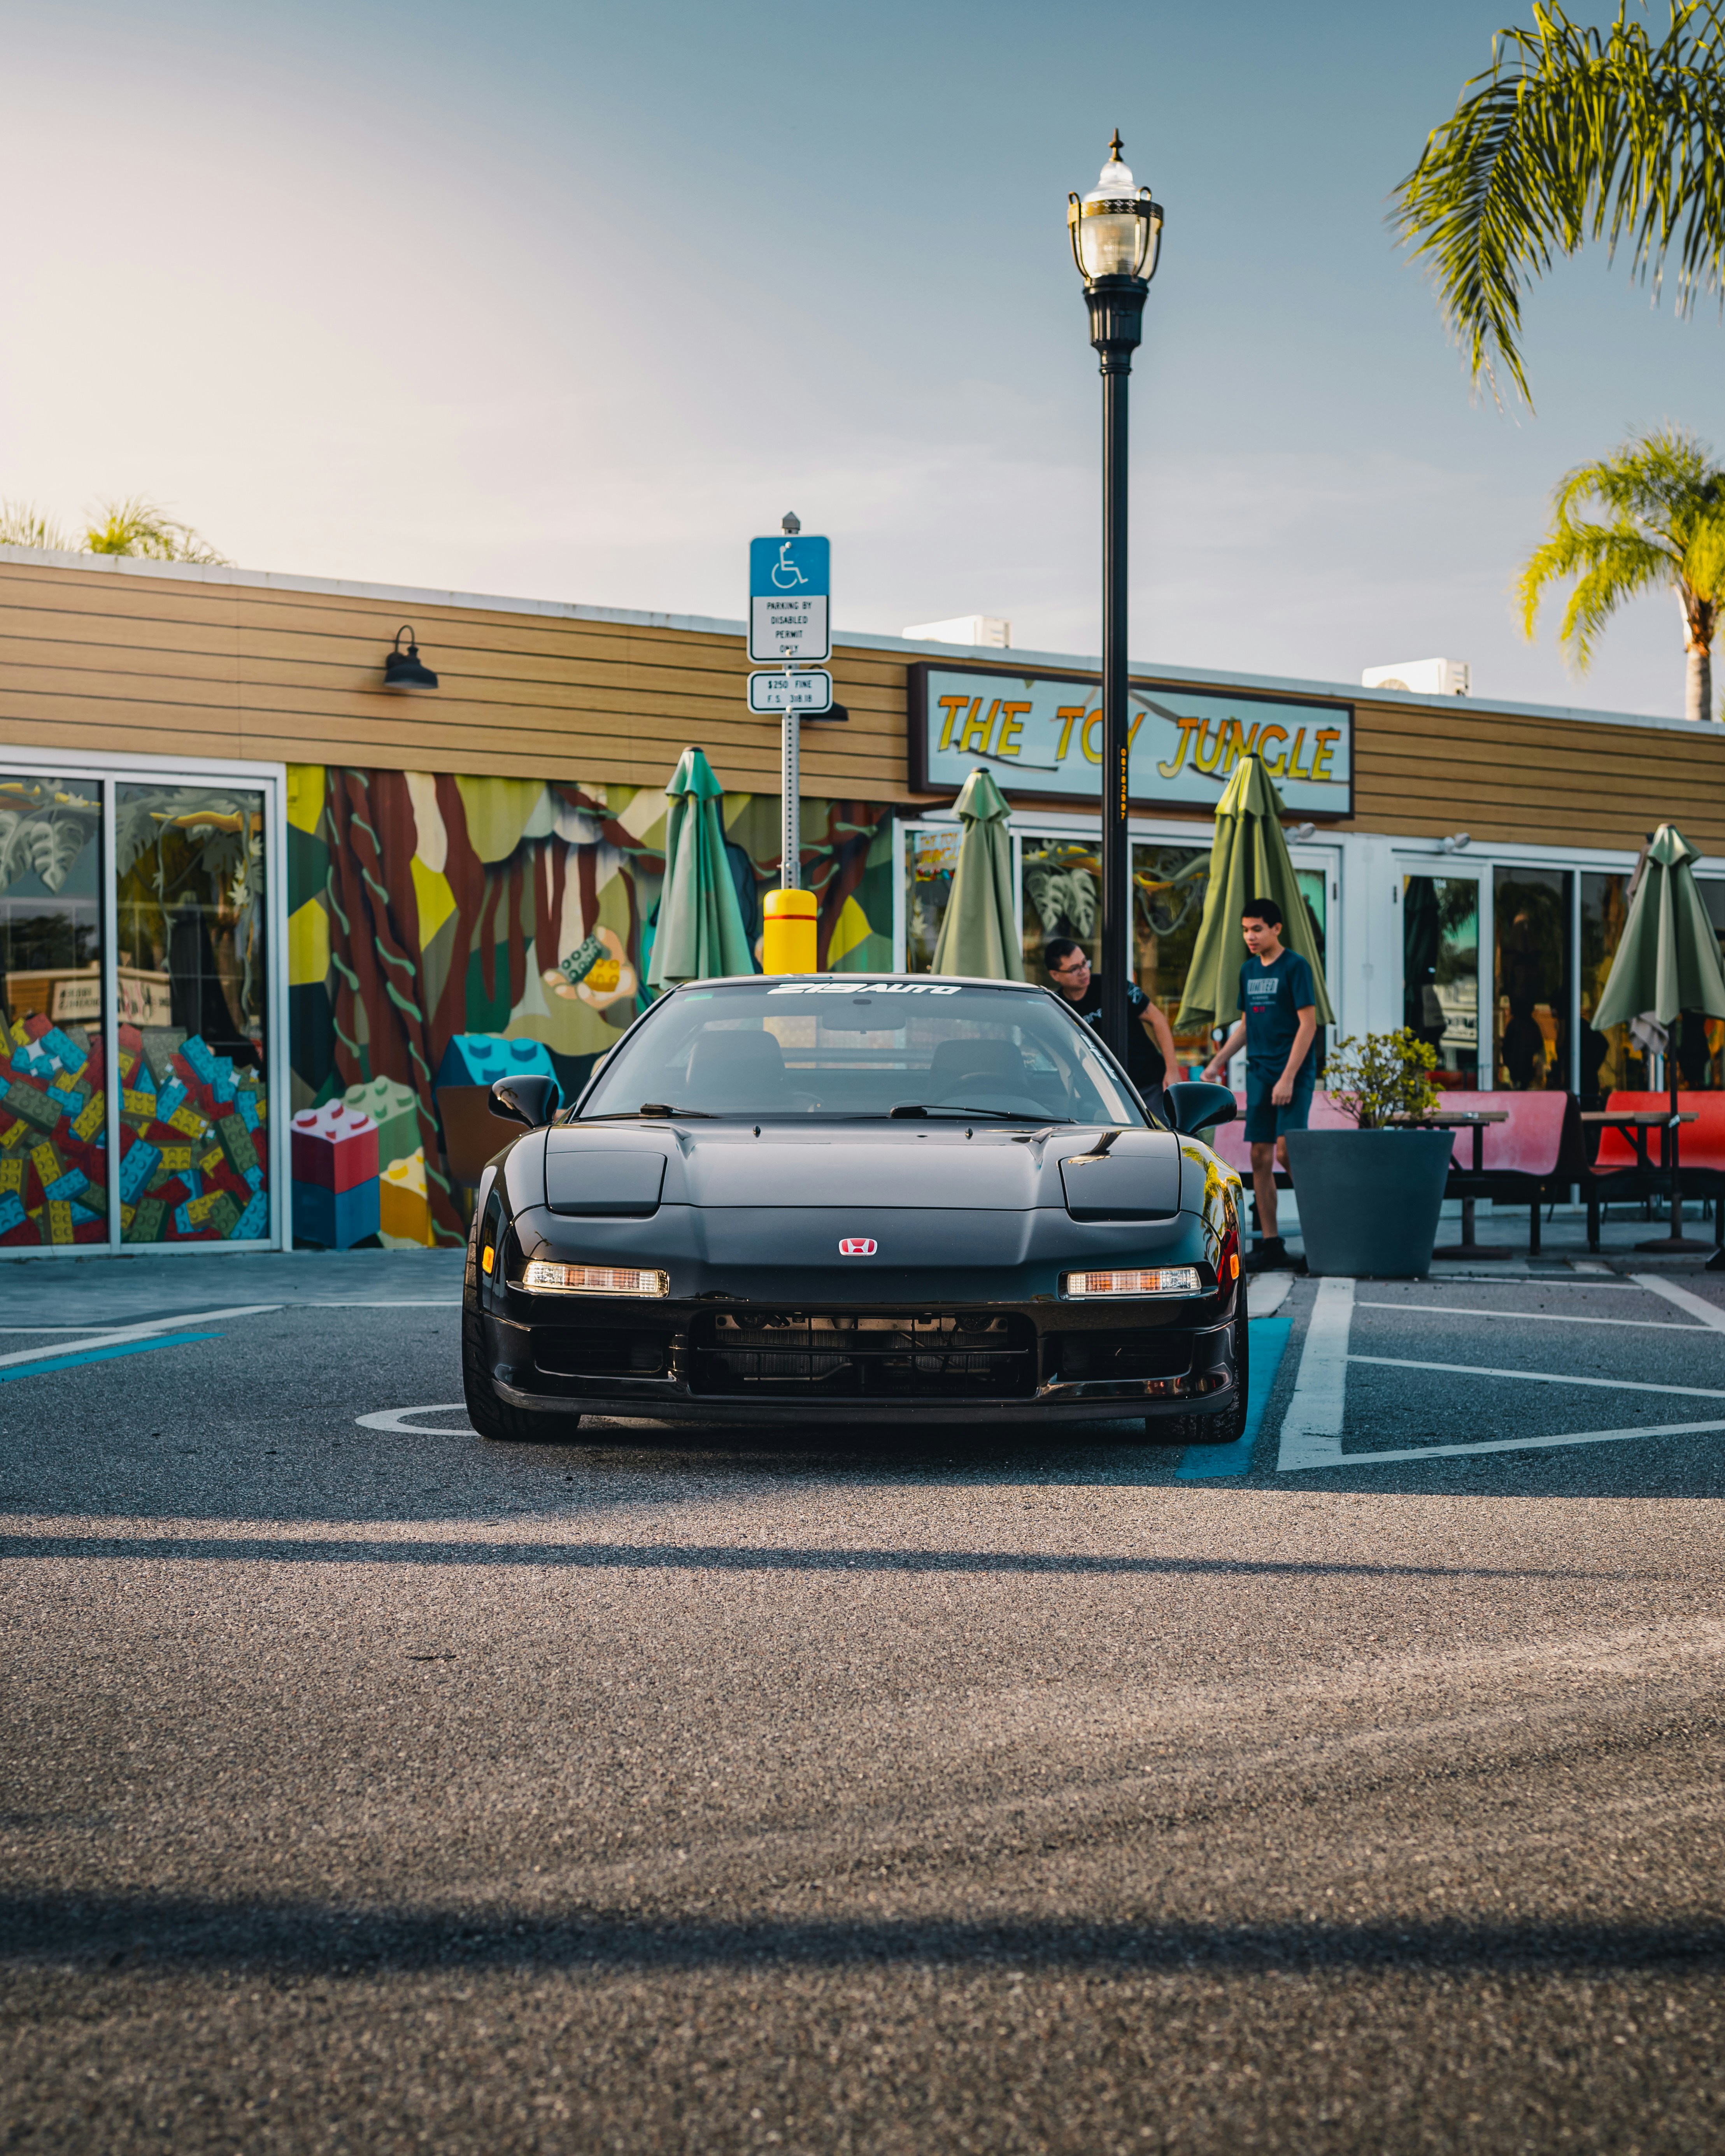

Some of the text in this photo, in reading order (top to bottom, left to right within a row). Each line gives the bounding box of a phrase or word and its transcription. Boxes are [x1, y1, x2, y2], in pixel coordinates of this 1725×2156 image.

[766, 601, 812, 610] PARKING BY
[771, 616, 808, 624] DISABLED
[775, 630, 803, 638] PERMIT
[768, 680, 812, 689] $250 FINE
[937, 695, 1032, 756] THE
[1157, 717, 1341, 780] JUNGLE
